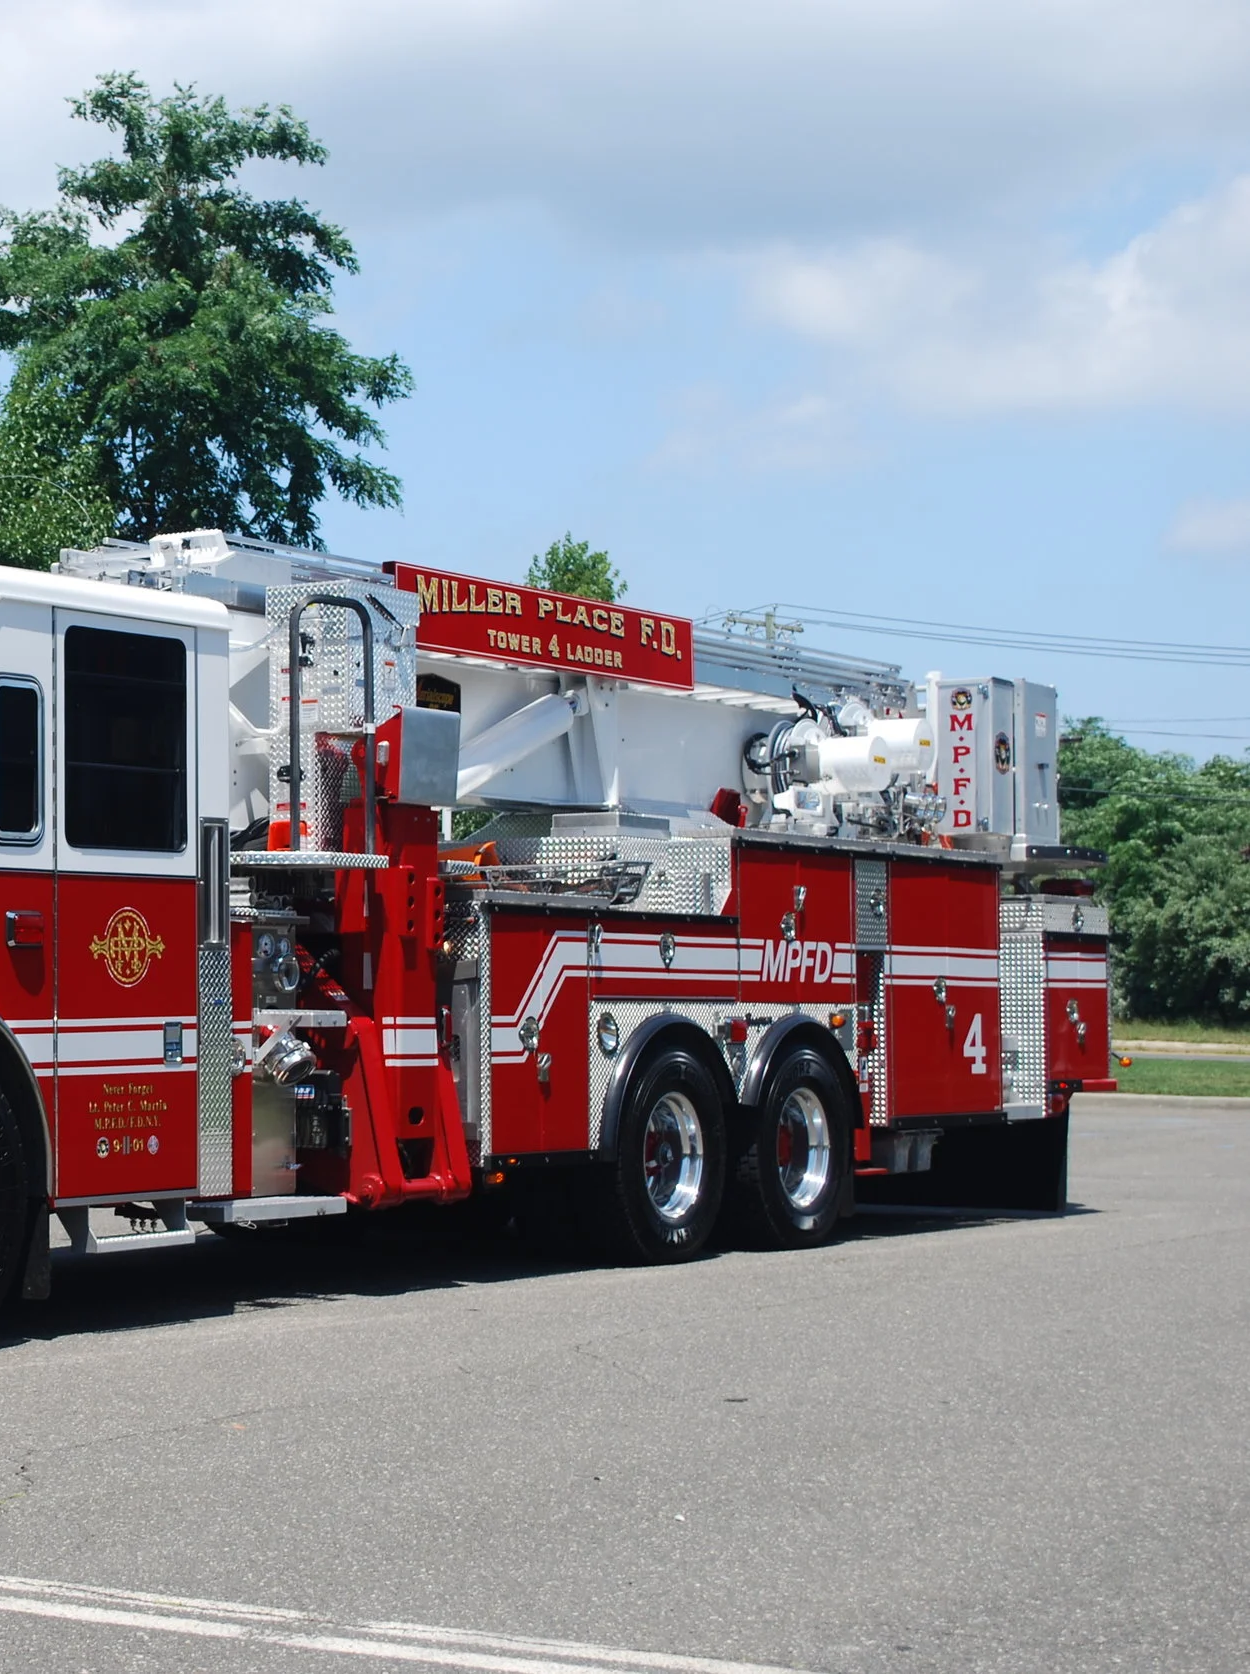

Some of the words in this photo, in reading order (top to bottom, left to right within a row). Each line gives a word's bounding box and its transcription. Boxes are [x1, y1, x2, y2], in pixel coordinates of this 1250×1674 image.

[415, 574, 523, 617] MILLER
[537, 596, 626, 638] PLACE
[640, 616, 682, 661] F.D.
[487, 628, 542, 656] TOWER
[548, 633, 560, 659] 4
[566, 642, 623, 669] LADDER
[761, 938, 834, 985] MPFD
[963, 1012, 988, 1075] 4
[103, 1083, 124, 1095] Never
[128, 1082, 153, 1097] Forget
[103, 1101, 124, 1113] Peter
[140, 1098, 168, 1111] Martin
